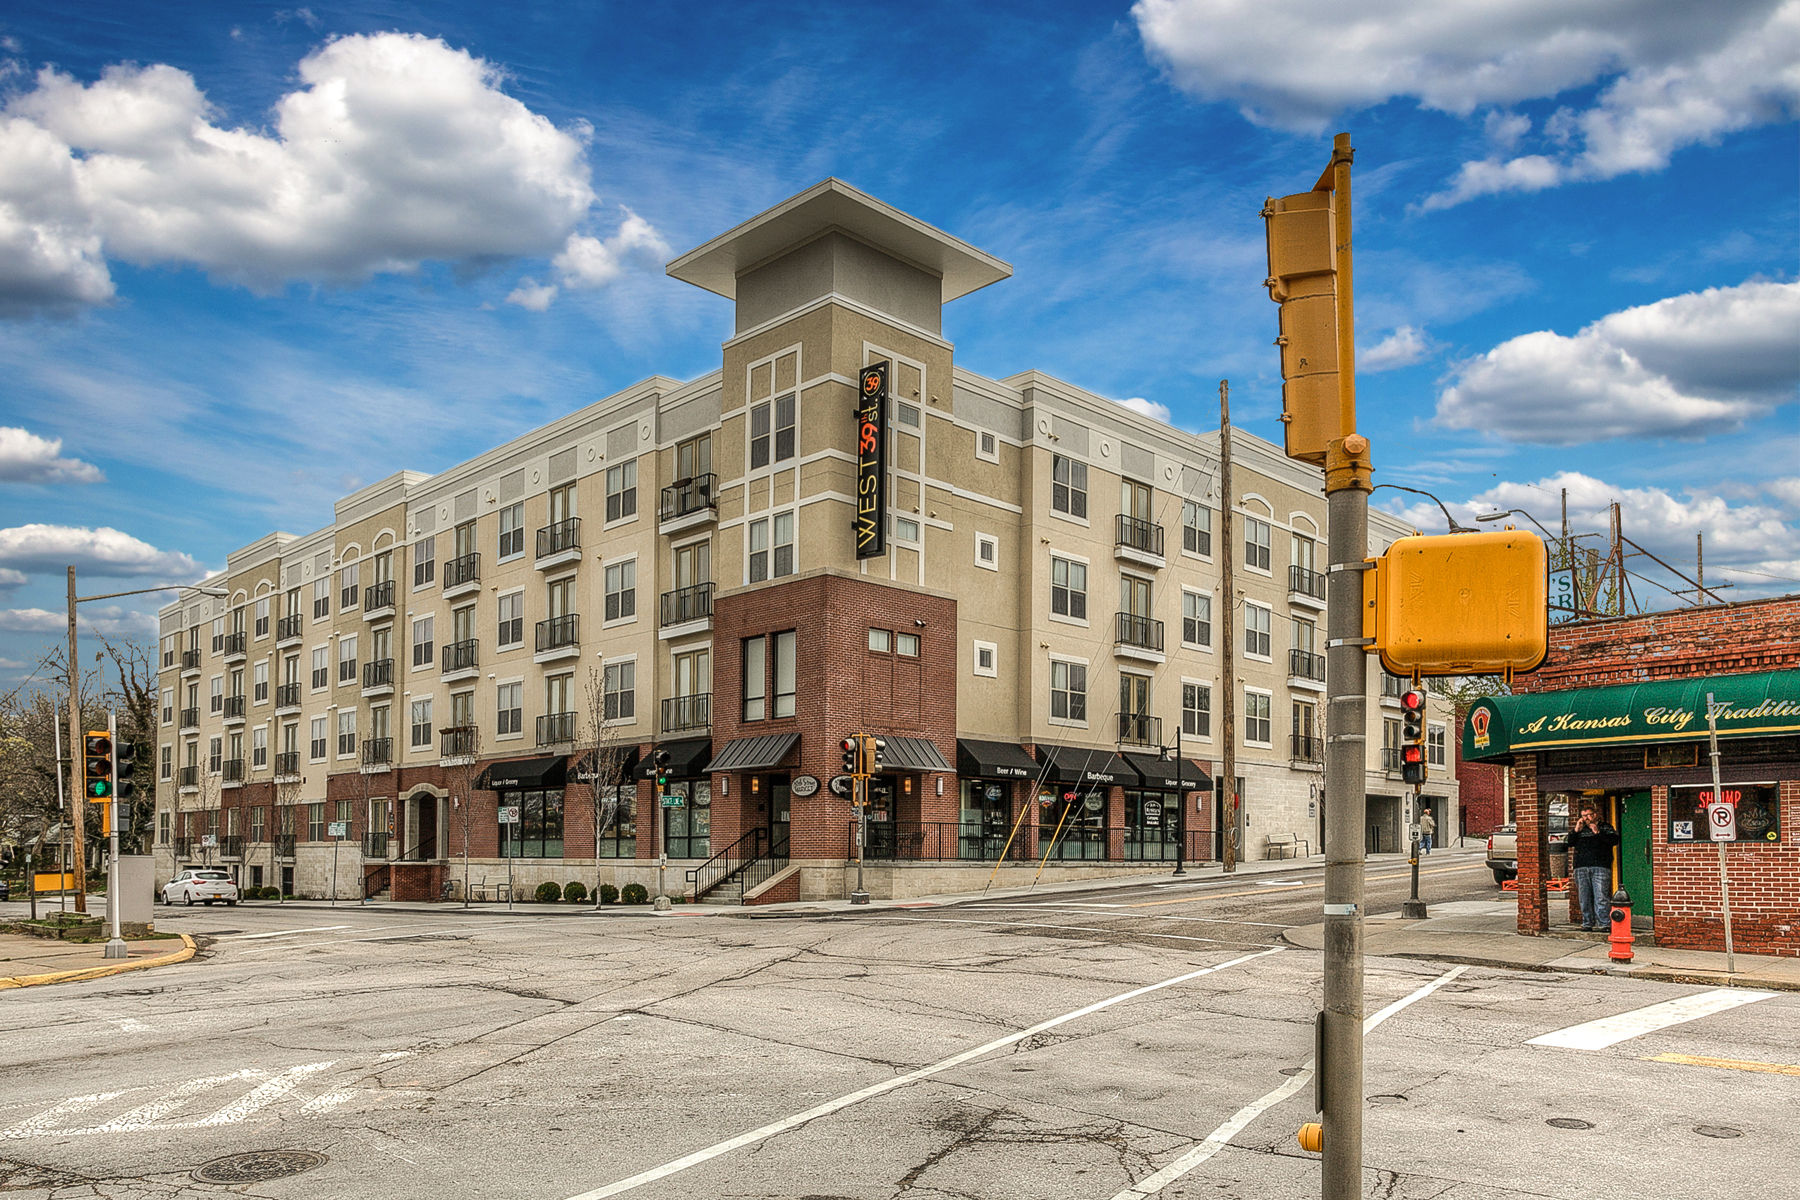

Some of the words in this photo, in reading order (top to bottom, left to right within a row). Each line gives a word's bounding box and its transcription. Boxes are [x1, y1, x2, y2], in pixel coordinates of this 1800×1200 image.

[865, 376, 880, 391] 39
[858, 456, 878, 549] WEST
[1518, 715, 1548, 734] A
[1547, 712, 1632, 732] Kansas
[1644, 706, 1695, 731] City
[996, 766, 1009, 775] Beer
[1014, 768, 1028, 776] Wine
[1087, 771, 1114, 782] Barbeque
[1181, 780, 1197, 789] Grocery
[1698, 790, 1742, 809] SHIMP
